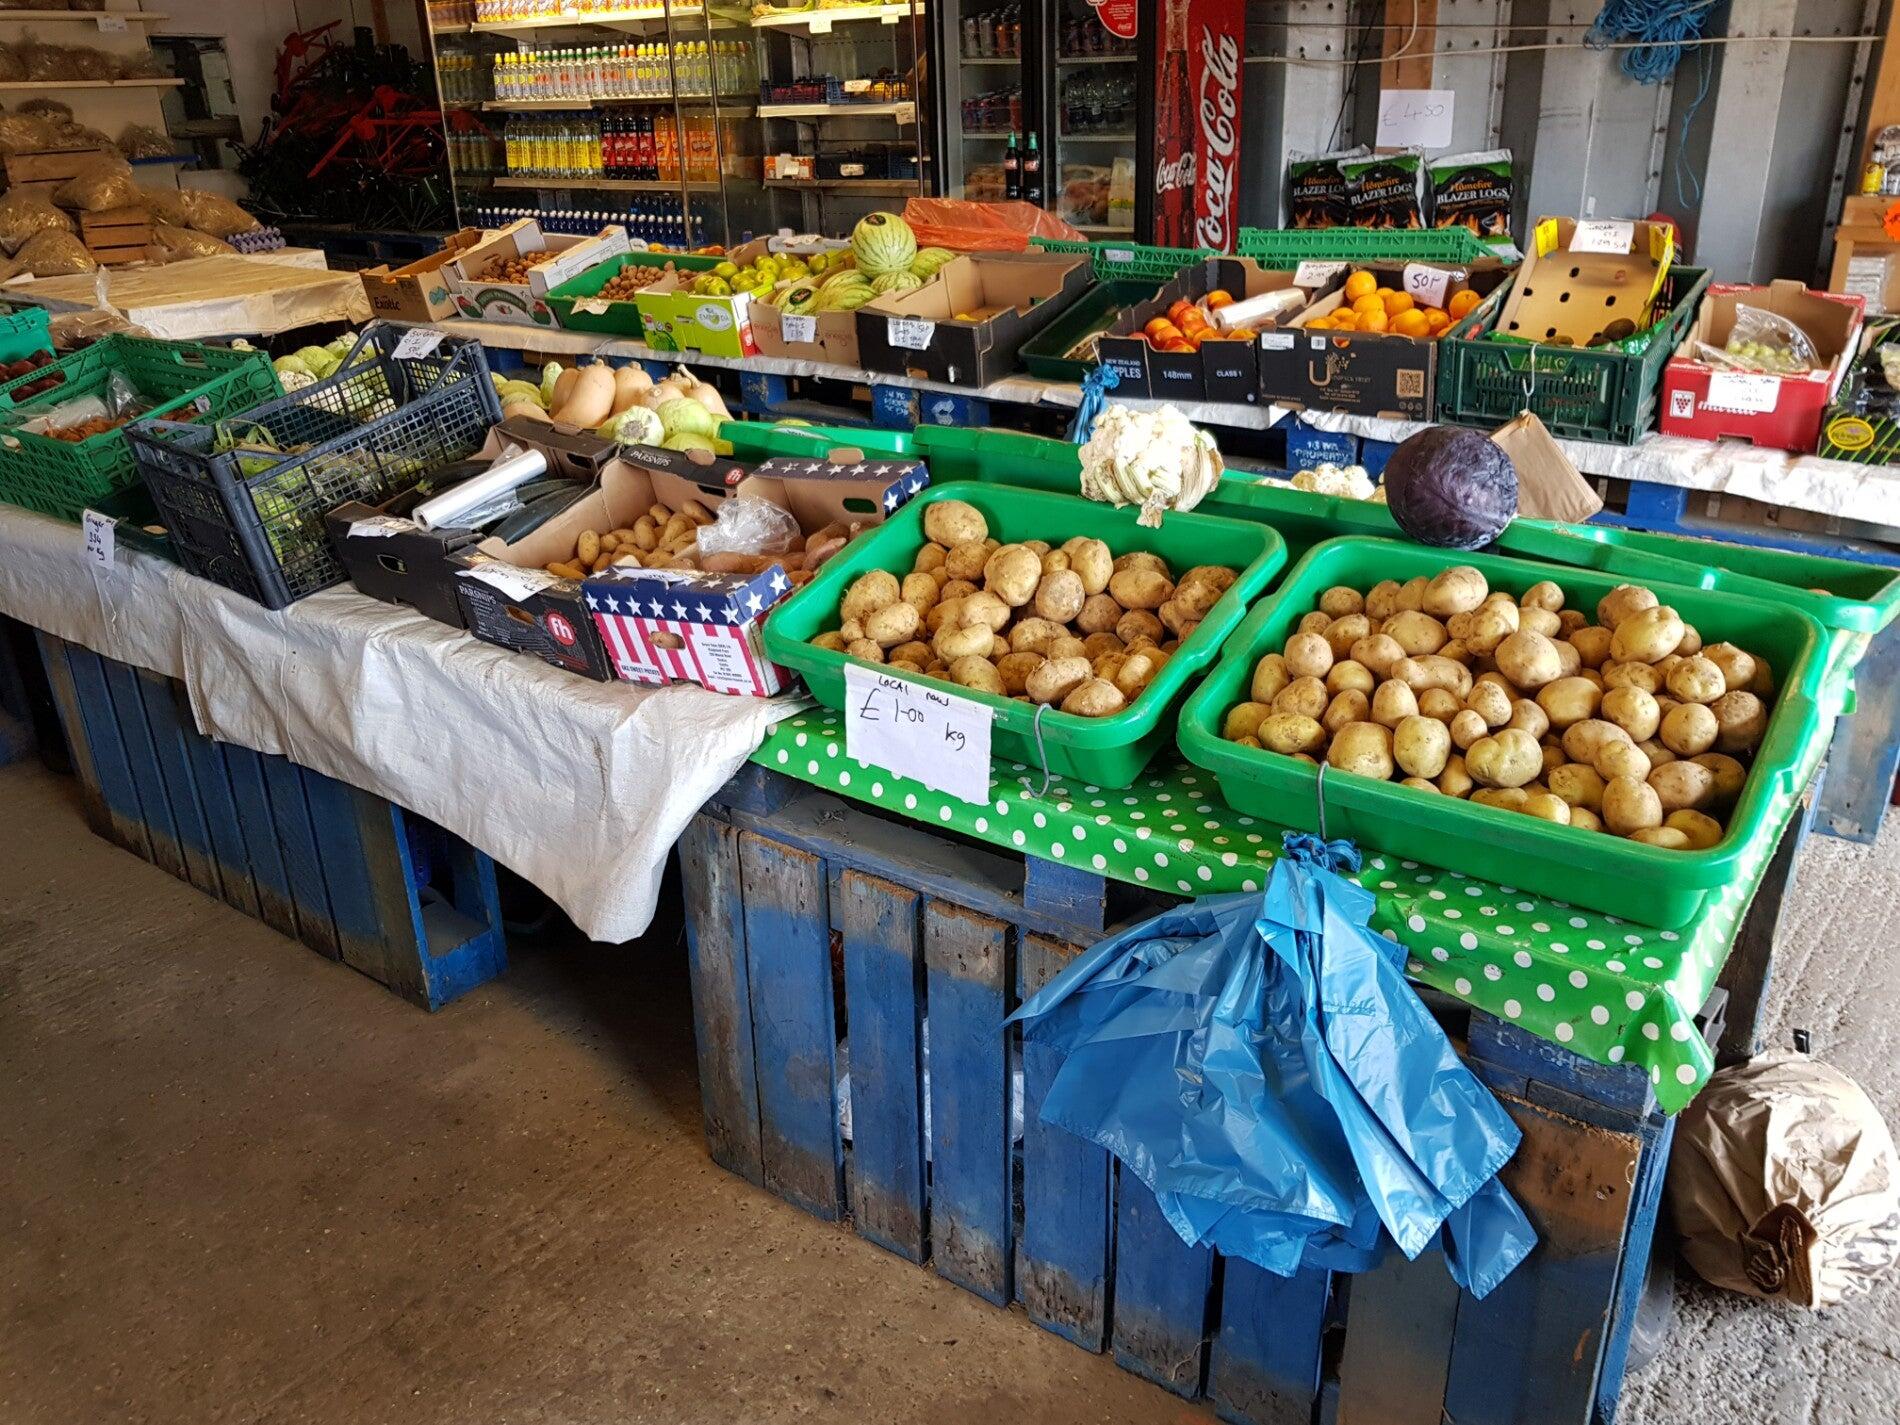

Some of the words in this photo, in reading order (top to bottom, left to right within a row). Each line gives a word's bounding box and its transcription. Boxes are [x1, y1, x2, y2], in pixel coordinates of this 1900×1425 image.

[1197, 24, 1238, 256] Coca-Cola
[1350, 188, 1388, 205] BLAZER
[1388, 182, 1413, 196] LOGS
[1437, 189, 1477, 204] BLAZER
[1480, 187, 1508, 198] LOGS
[1216, 370, 1237, 378] CLASS
[630, 450, 672, 468] PARSNIPS
[459, 584, 497, 605] PARSNIPS
